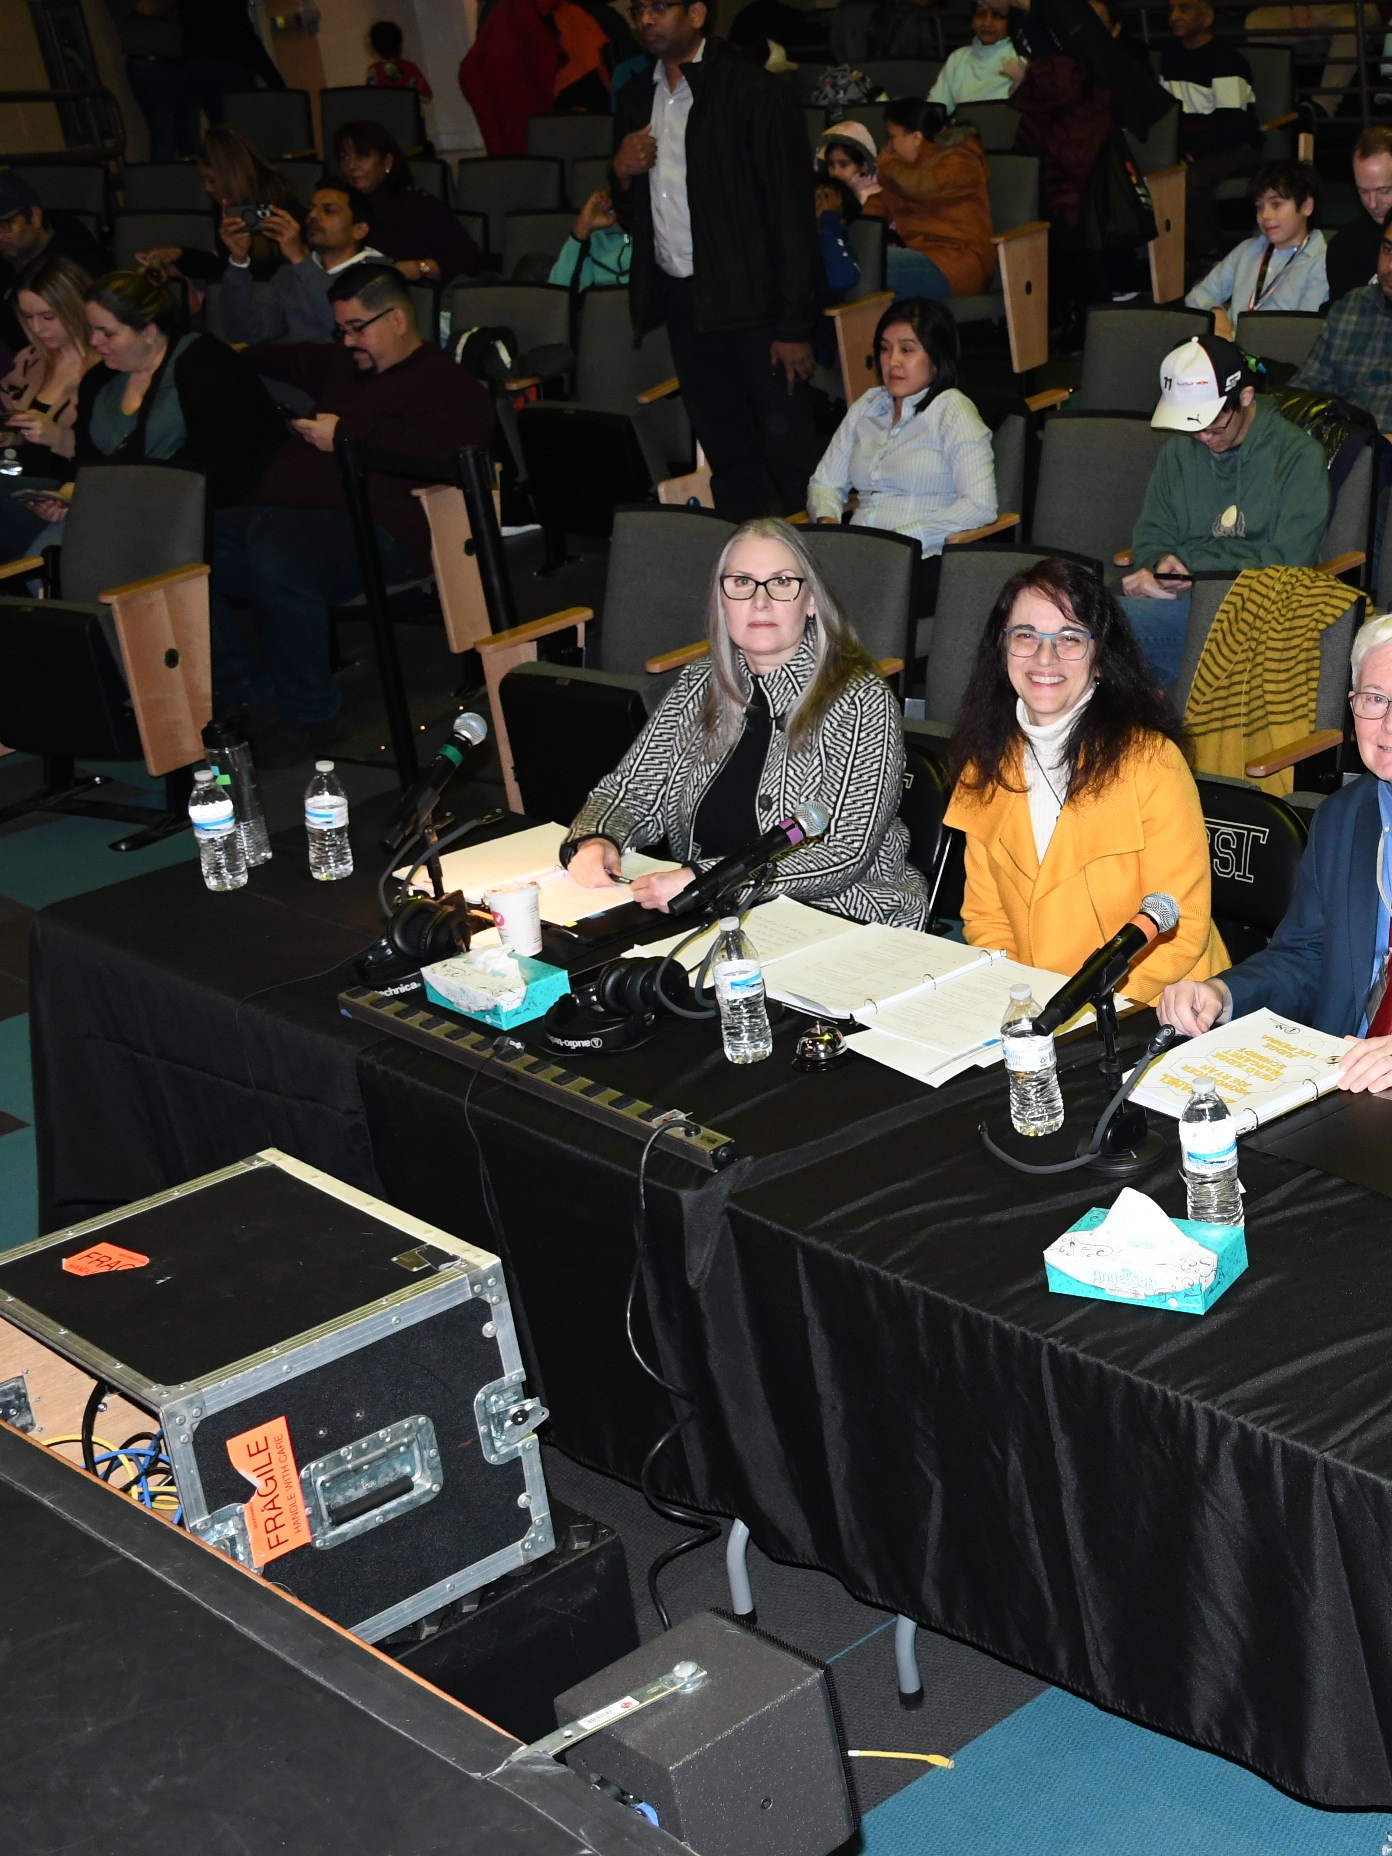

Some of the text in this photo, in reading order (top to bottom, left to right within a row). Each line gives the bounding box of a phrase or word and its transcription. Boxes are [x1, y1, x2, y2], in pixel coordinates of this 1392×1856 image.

[1160, 1073, 1196, 1095] ANEL
[246, 1435, 290, 1551] FRAGILE
[273, 1433, 302, 1535] HANDLE WITH CARE
